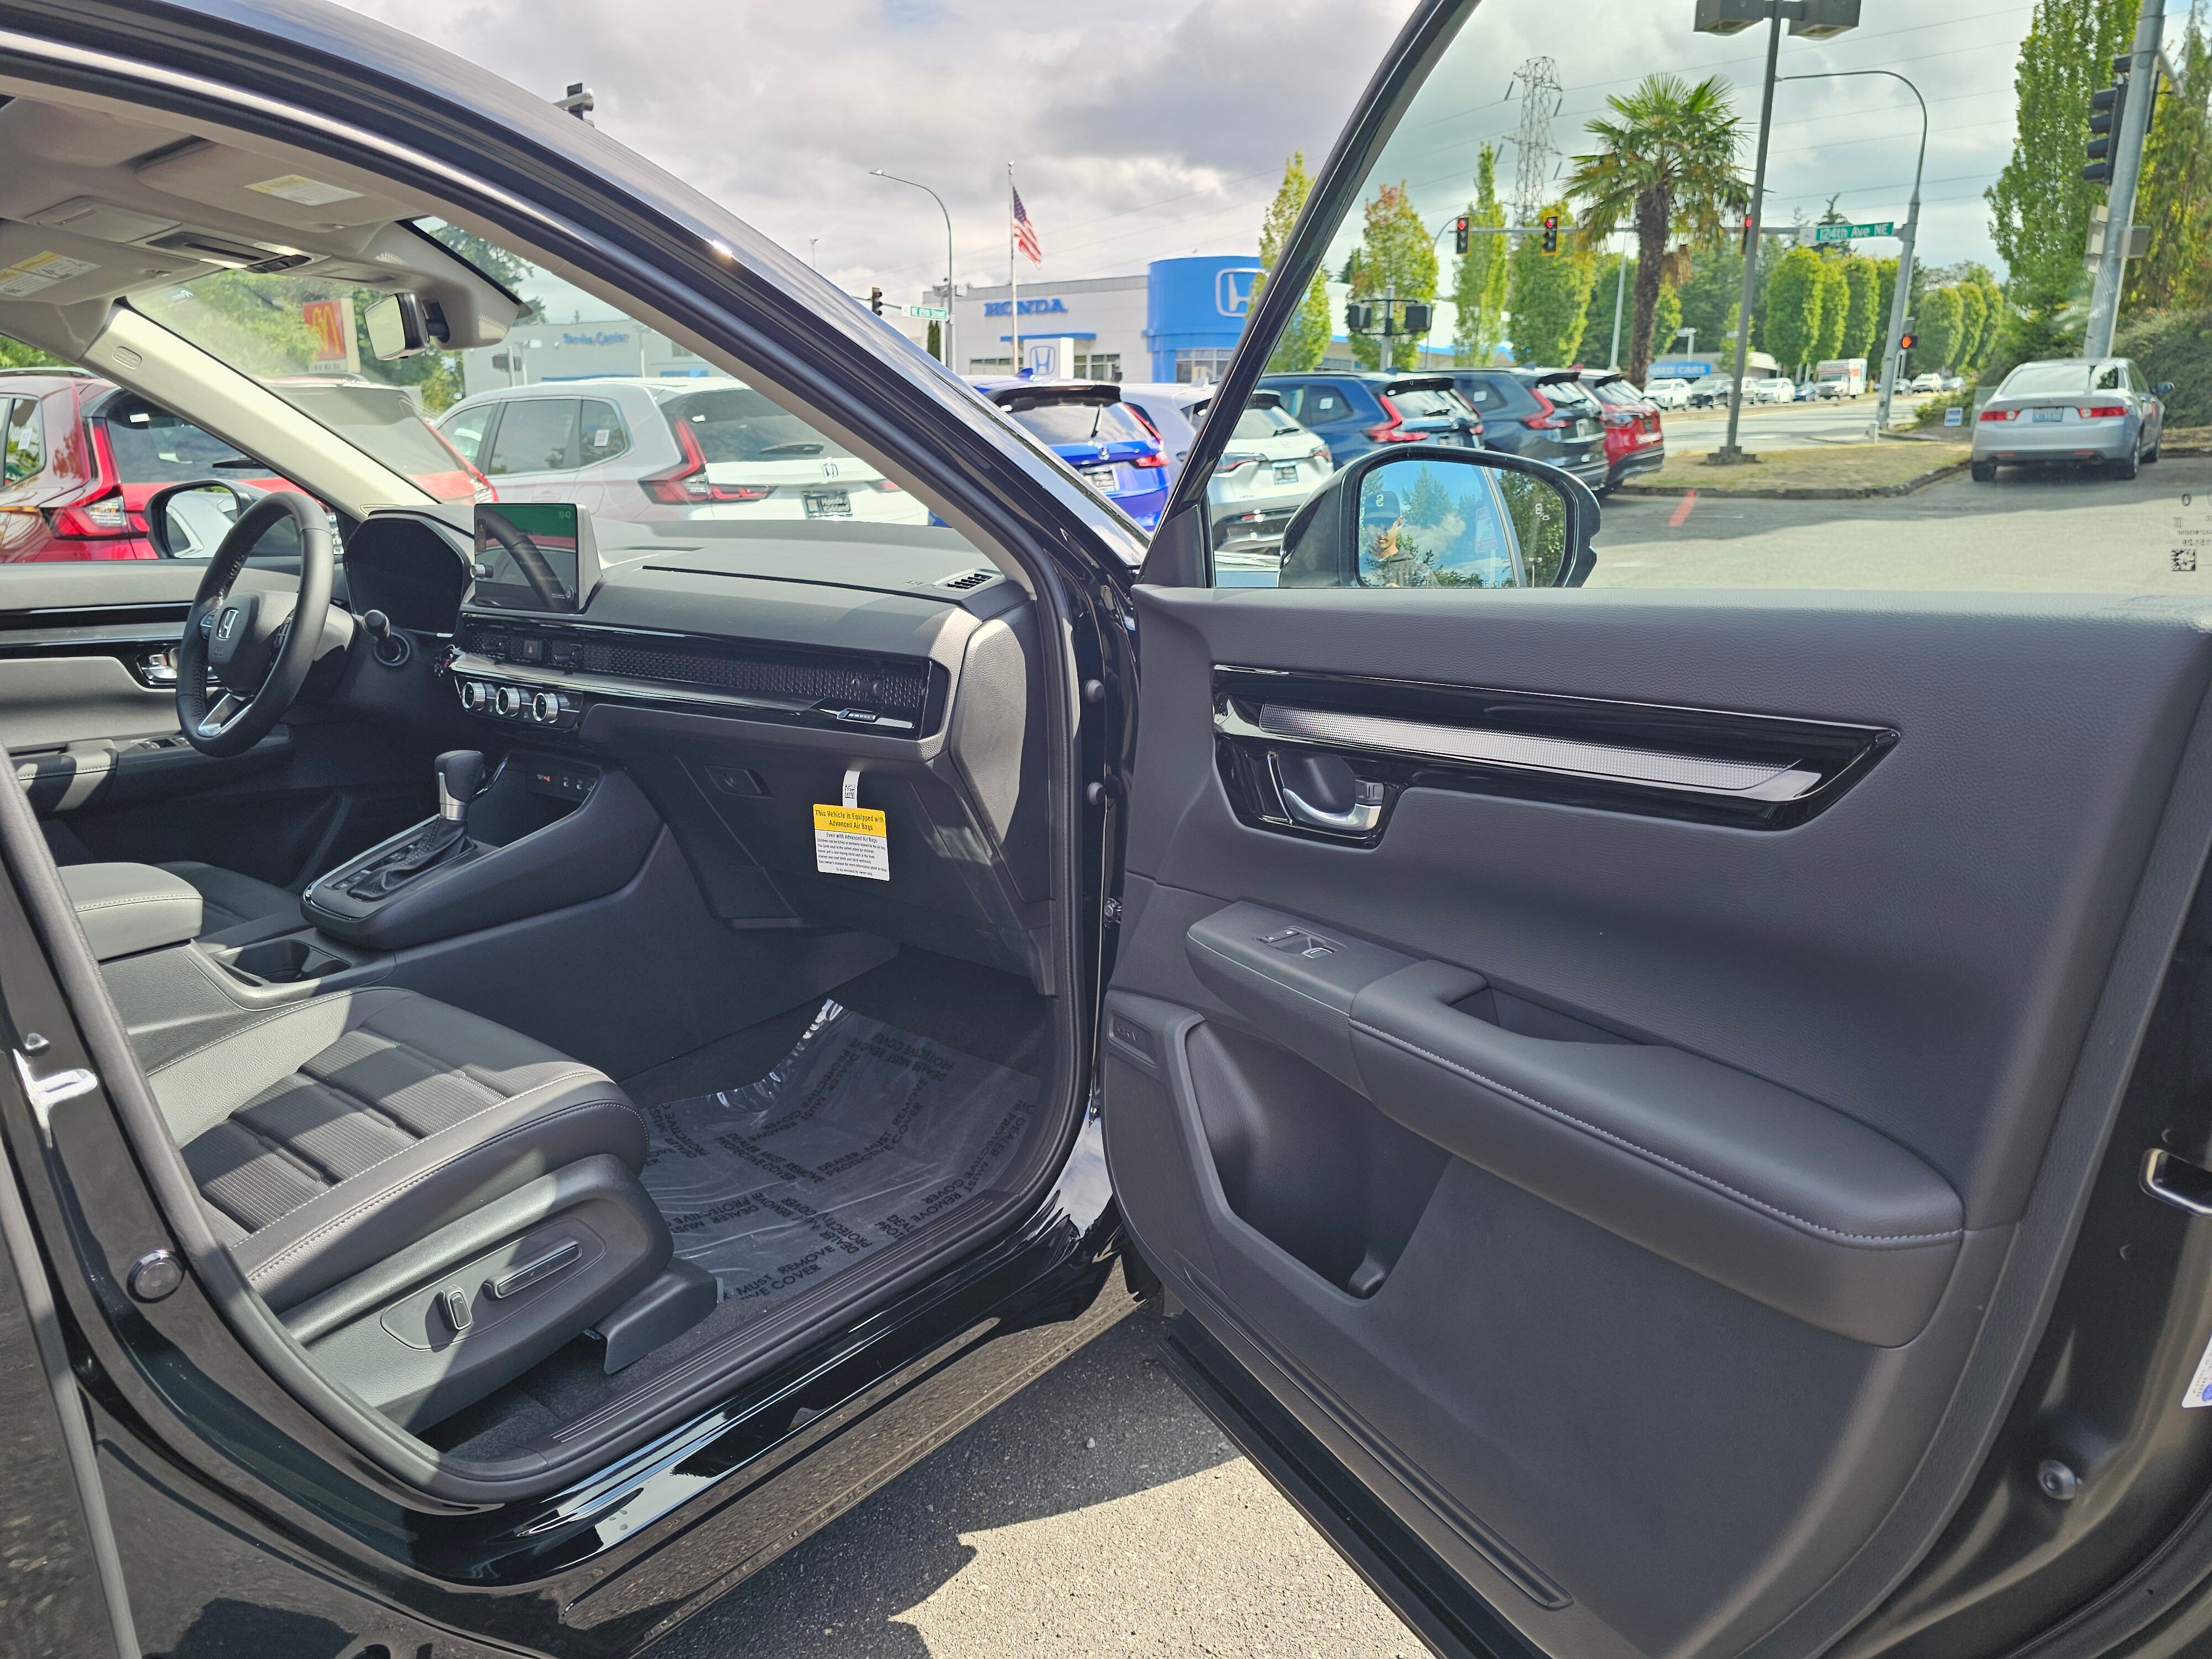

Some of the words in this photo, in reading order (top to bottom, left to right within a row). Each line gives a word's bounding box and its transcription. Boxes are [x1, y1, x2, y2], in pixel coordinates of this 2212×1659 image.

[1819, 227, 1848, 241] 124th
[1850, 226, 1870, 237] Ave
[1874, 223, 1889, 236] NE
[984, 299, 1068, 317] HONDA
[1677, 366, 1705, 374] CARS
[852, 813, 873, 822] Equipped
[862, 823, 873, 831] Bags
[817, 1151, 861, 1172] DEALER
[863, 1131, 892, 1153] MUST
[891, 1078, 927, 1126] REMOVE
[828, 1144, 894, 1177] PROTECTIVE
[892, 1100, 924, 1144] COVER
[714, 1136, 764, 1166] PROTECTIVE
[762, 1162, 797, 1181] COVER
[725, 1133, 761, 1154] DEALER
[759, 1151, 786, 1164] MUST
[784, 1162, 825, 1184] REMOVE
[964, 1161, 989, 1193] MUST
[922, 1178, 964, 1204] COVER
[712, 1204, 760, 1224] DEALER
[751, 1192, 795, 1217] REMOVE
[781, 1197, 817, 1217] COVER
[911, 1192, 962, 1222] REMOVE
[670, 1220, 706, 1234] MUST
[819, 1230, 859, 1254] DEALER
[736, 1273, 773, 1296] MUST
[777, 1245, 836, 1275] REMOVE
[771, 1264, 822, 1290] COVER
